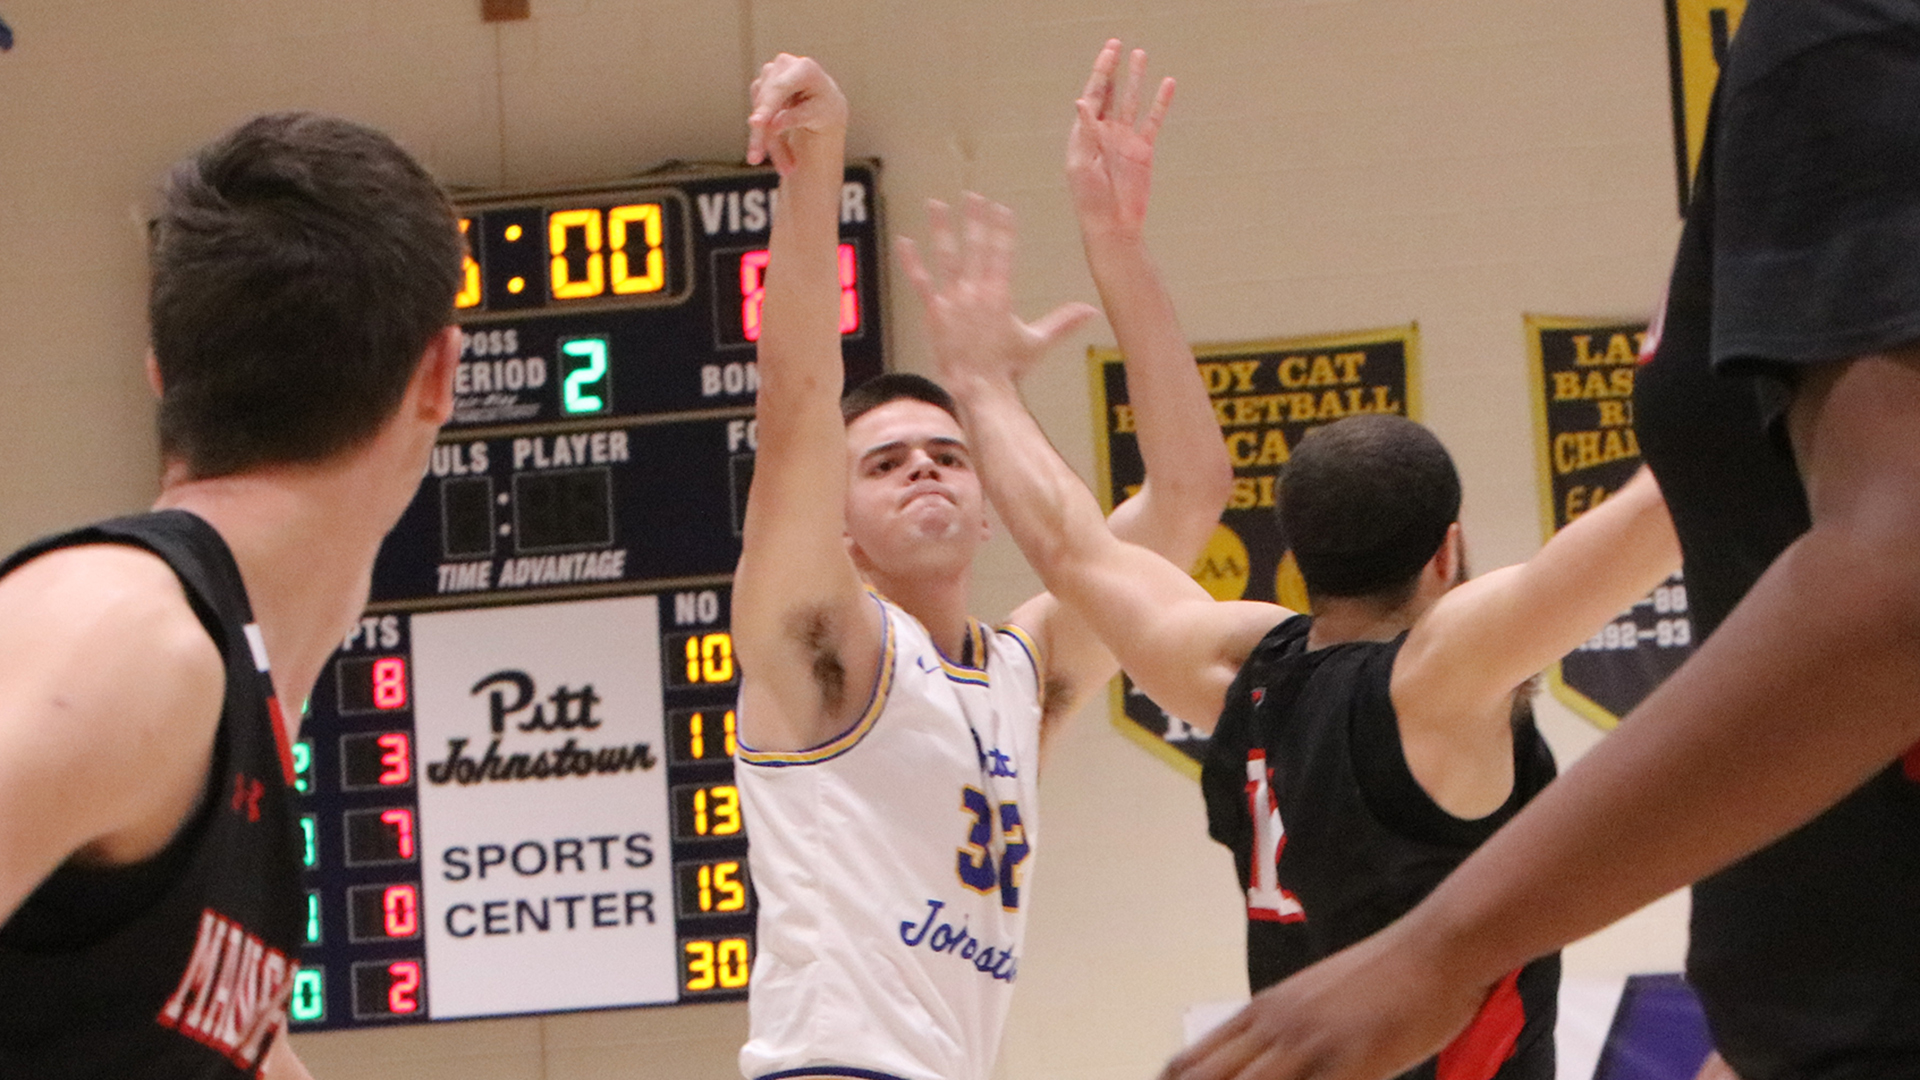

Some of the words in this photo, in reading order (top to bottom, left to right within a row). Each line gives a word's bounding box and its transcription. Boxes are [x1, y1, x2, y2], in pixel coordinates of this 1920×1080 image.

[700, 183, 866, 234] VISR
[454, 357, 547, 394] ERIOD
[563, 339, 607, 413] 2
[1200, 361, 1261, 393] DY
[1277, 352, 1367, 388] CAT
[1115, 386, 1399, 433] BKETBALL
[421, 441, 489, 477] ULS
[513, 431, 629, 468] PLAYER
[437, 564, 494, 593] TIME
[498, 550, 627, 587] ADVANTAGE
[342, 615, 399, 651] PTS
[675, 592, 718, 624] NO
[686, 633, 733, 683] 10
[373, 657, 406, 710] 8
[471, 670, 602, 734] Pitt
[377, 733, 410, 786] 3
[690, 710, 737, 759] 11
[427, 738, 656, 786] Johnstown
[381, 808, 413, 859] 7
[694, 785, 741, 835] 13
[442, 833, 654, 882] SPORTS
[956, 783, 1030, 913] 32
[383, 884, 417, 938] 0
[699, 861, 745, 912] 15
[445, 891, 656, 938] CENTER
[388, 961, 420, 1014] 2
[685, 938, 749, 991] 30
